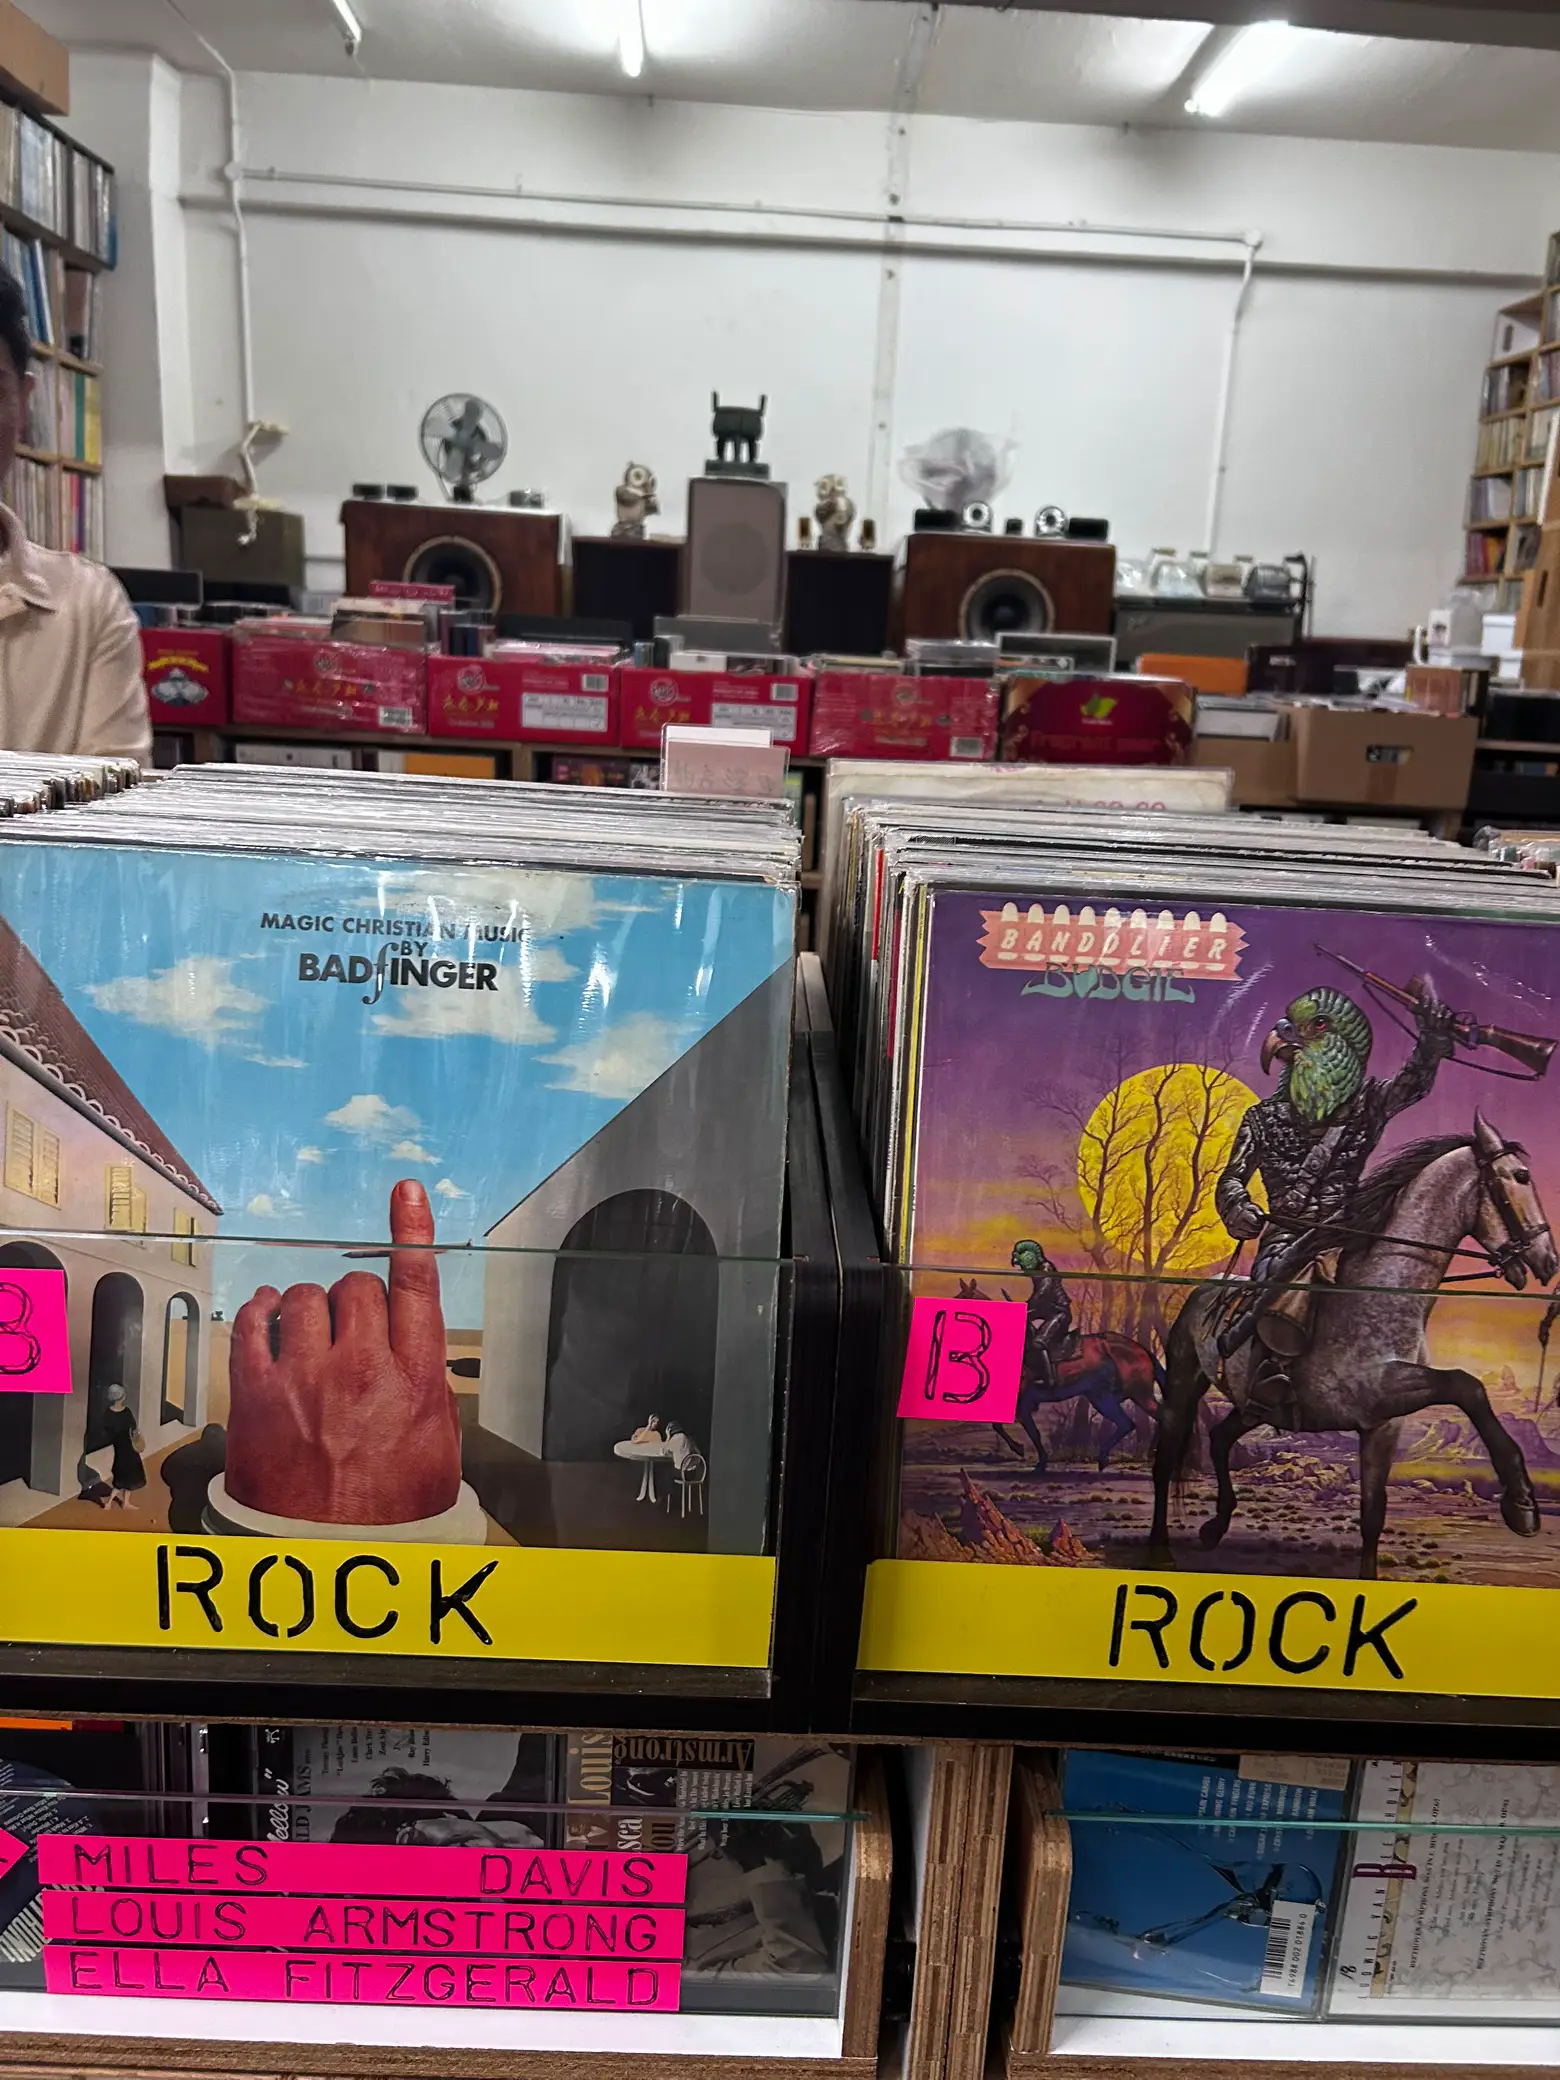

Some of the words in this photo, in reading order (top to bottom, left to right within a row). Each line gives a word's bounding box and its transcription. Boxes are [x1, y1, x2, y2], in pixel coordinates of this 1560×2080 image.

[260, 912, 334, 933] MAGIC
[343, 917, 456, 940] CHRISTIAN
[400, 940, 428, 958] BY
[1000, 929, 1227, 961] BANDOLIER
[157, 1544, 498, 1646] ROCK
[1109, 1583, 1418, 1680] ROCK
[567, 1733, 614, 1806] Louis
[614, 1736, 754, 1772] Armstrong
[74, 1843, 268, 1886] MILES
[480, 1853, 655, 1897] DAVIS
[71, 1897, 247, 1941] LOUIS
[304, 1904, 657, 1953] ARMSTRONG
[70, 1951, 229, 1993] ELLA
[285, 1959, 659, 2006] FITZGERALD
